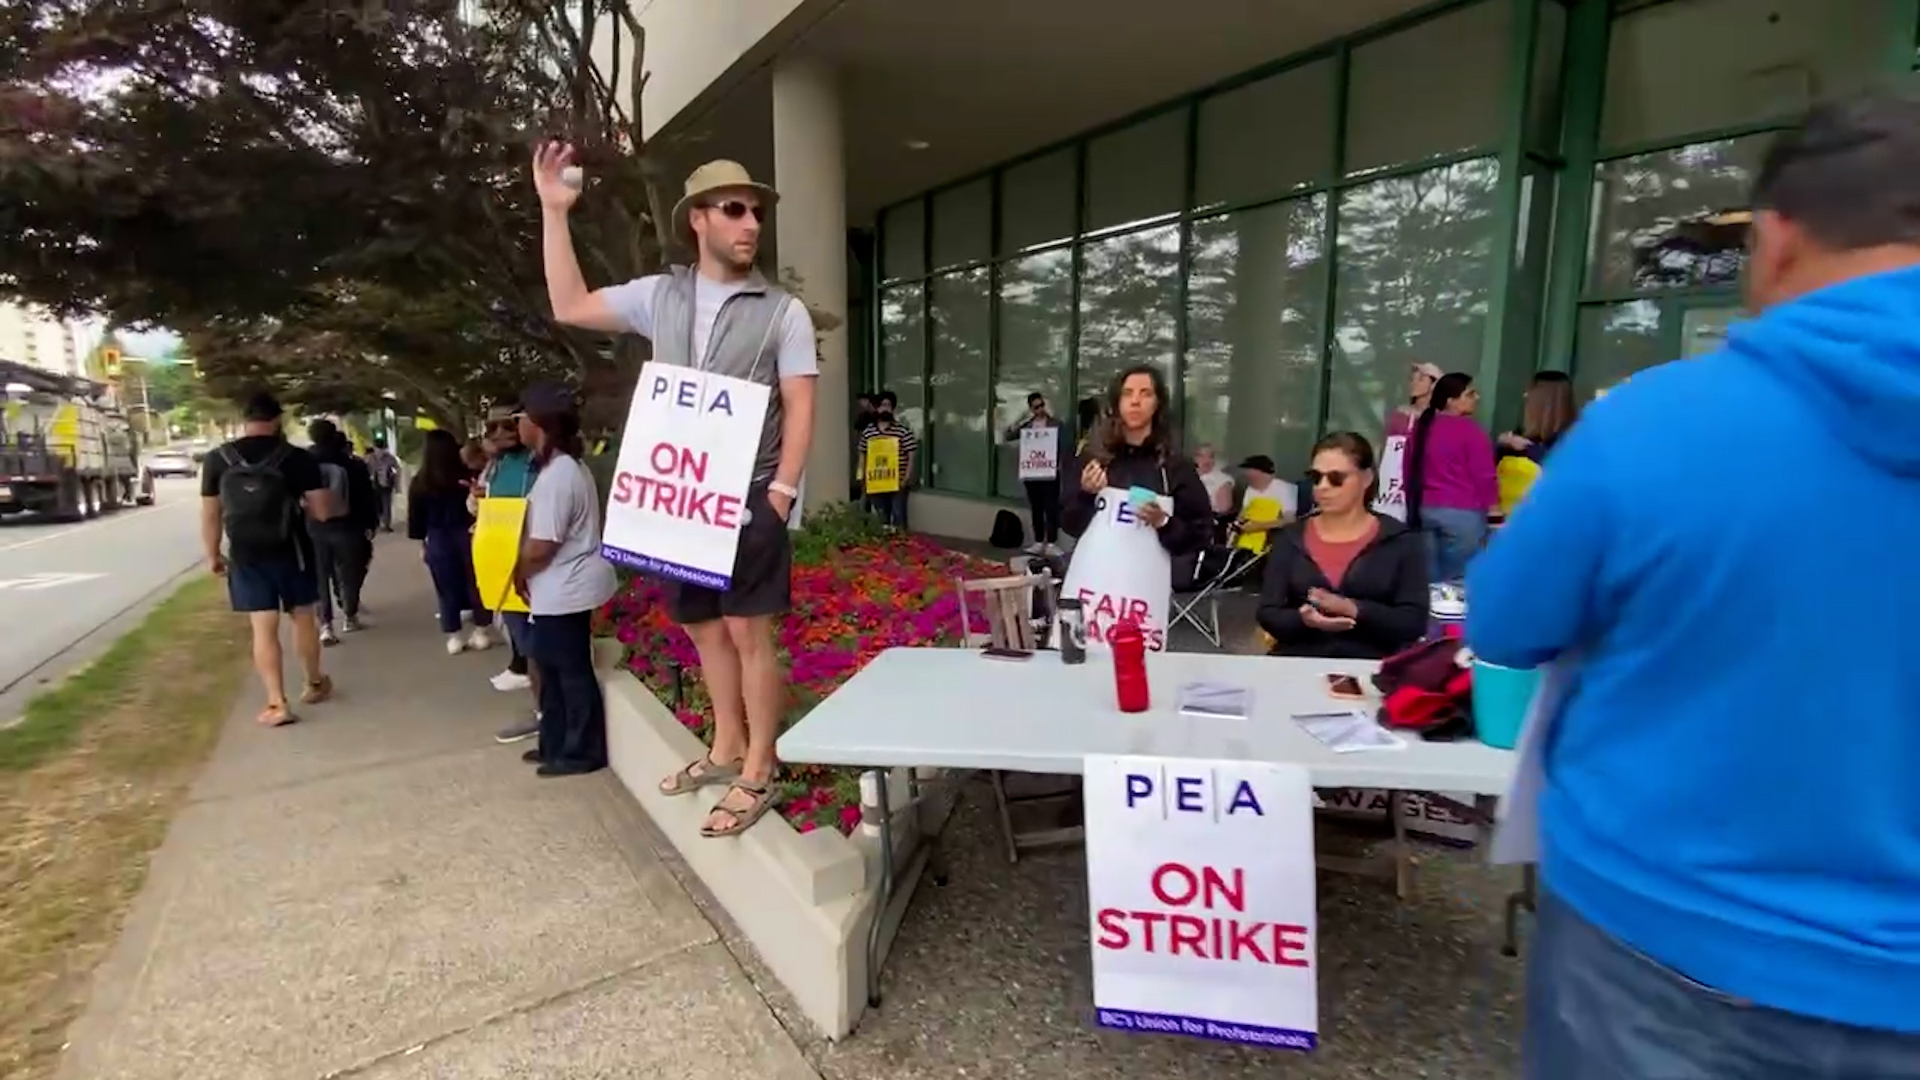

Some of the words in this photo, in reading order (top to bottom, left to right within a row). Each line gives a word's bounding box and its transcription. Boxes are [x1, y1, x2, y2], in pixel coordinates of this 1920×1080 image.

[650, 442, 709, 483] ON
[613, 472, 741, 529] STRIKE
[1151, 862, 1244, 912] ON
[1097, 908, 1309, 966] STRIKE
[1134, 1014, 1180, 1031] Union
[1181, 1019, 1205, 1034] for
[1206, 1023, 1312, 1049] Professionals
